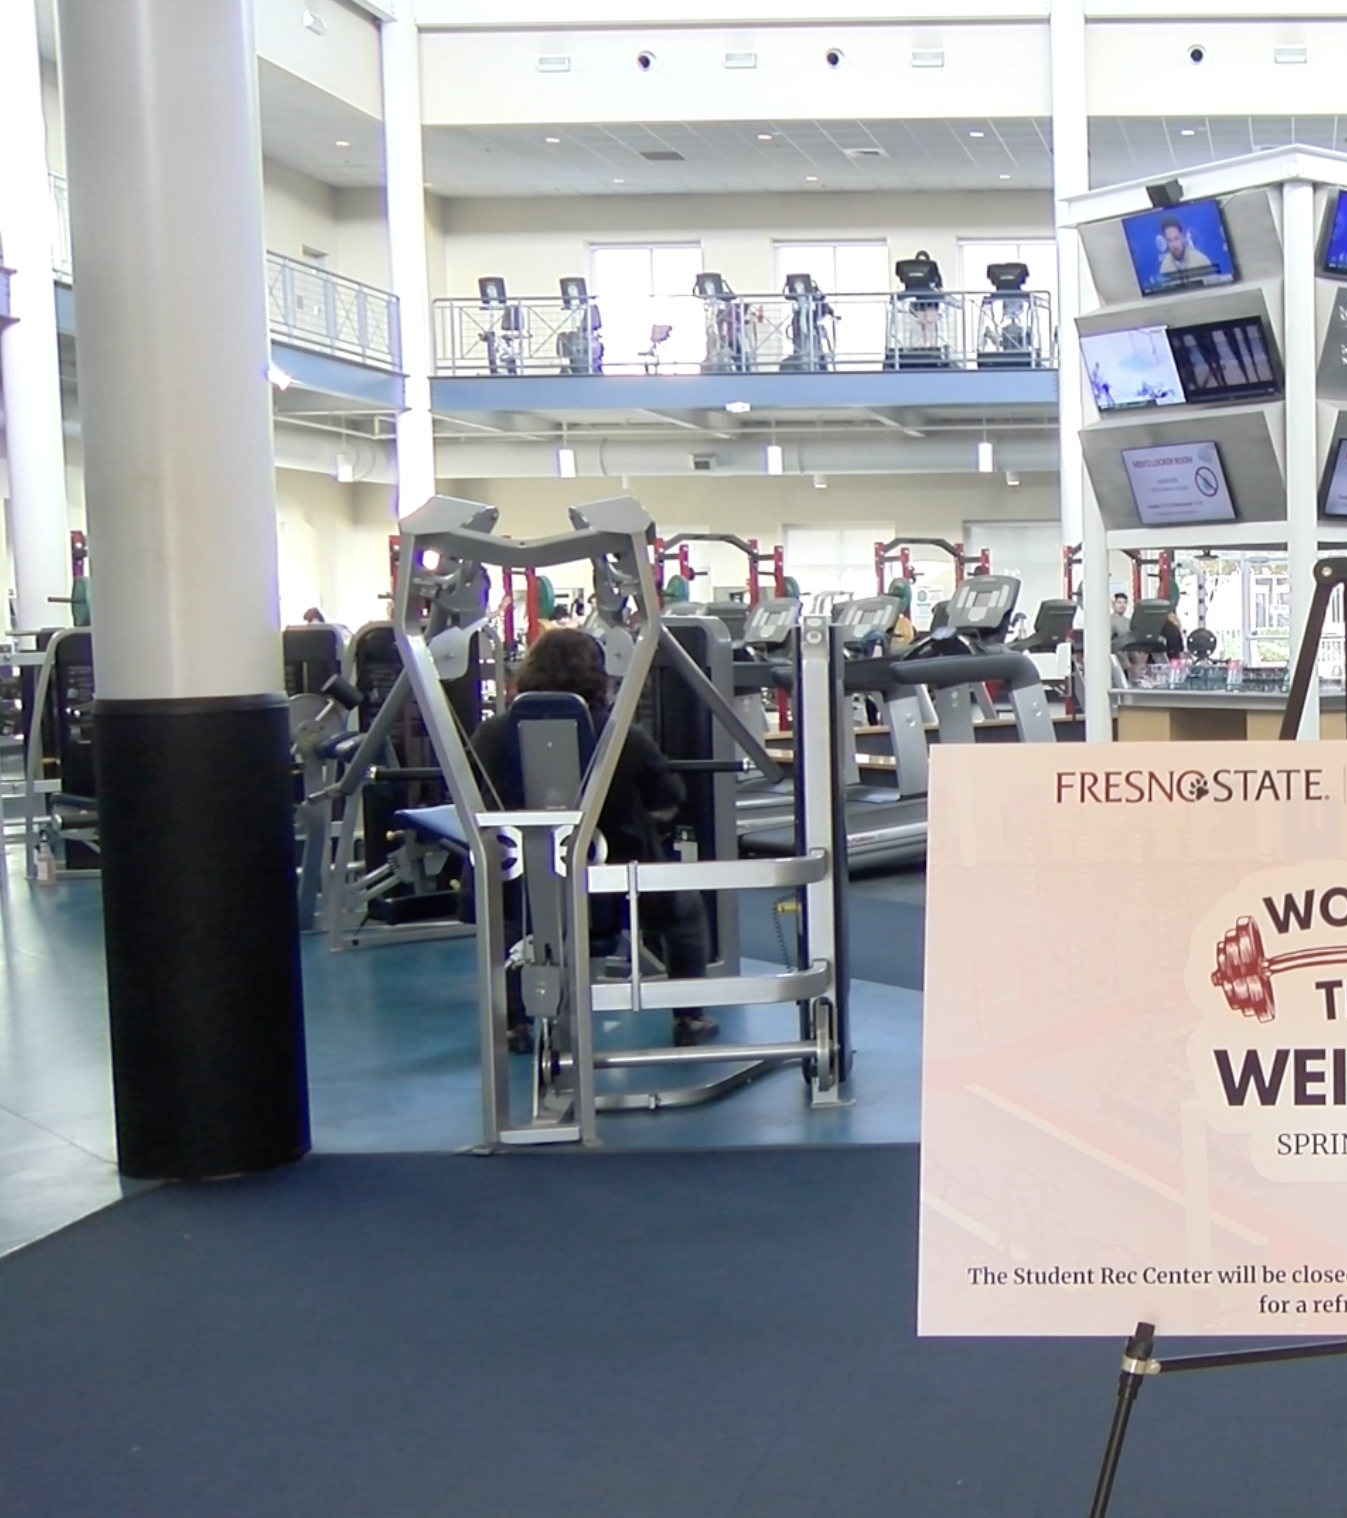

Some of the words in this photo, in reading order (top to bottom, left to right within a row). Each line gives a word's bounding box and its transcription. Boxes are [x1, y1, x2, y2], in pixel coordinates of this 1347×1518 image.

[1056, 769, 1209, 804] FRESNO
[967, 1266, 1008, 1285] The
[1013, 1266, 1094, 1285] Student
[1100, 1267, 1138, 1285] Rec
[1142, 1267, 1213, 1285] Center
[1217, 1264, 1257, 1284] will
[1262, 1264, 1287, 1284] be
[1259, 1294, 1291, 1314] for
[1295, 1300, 1307, 1314] a
